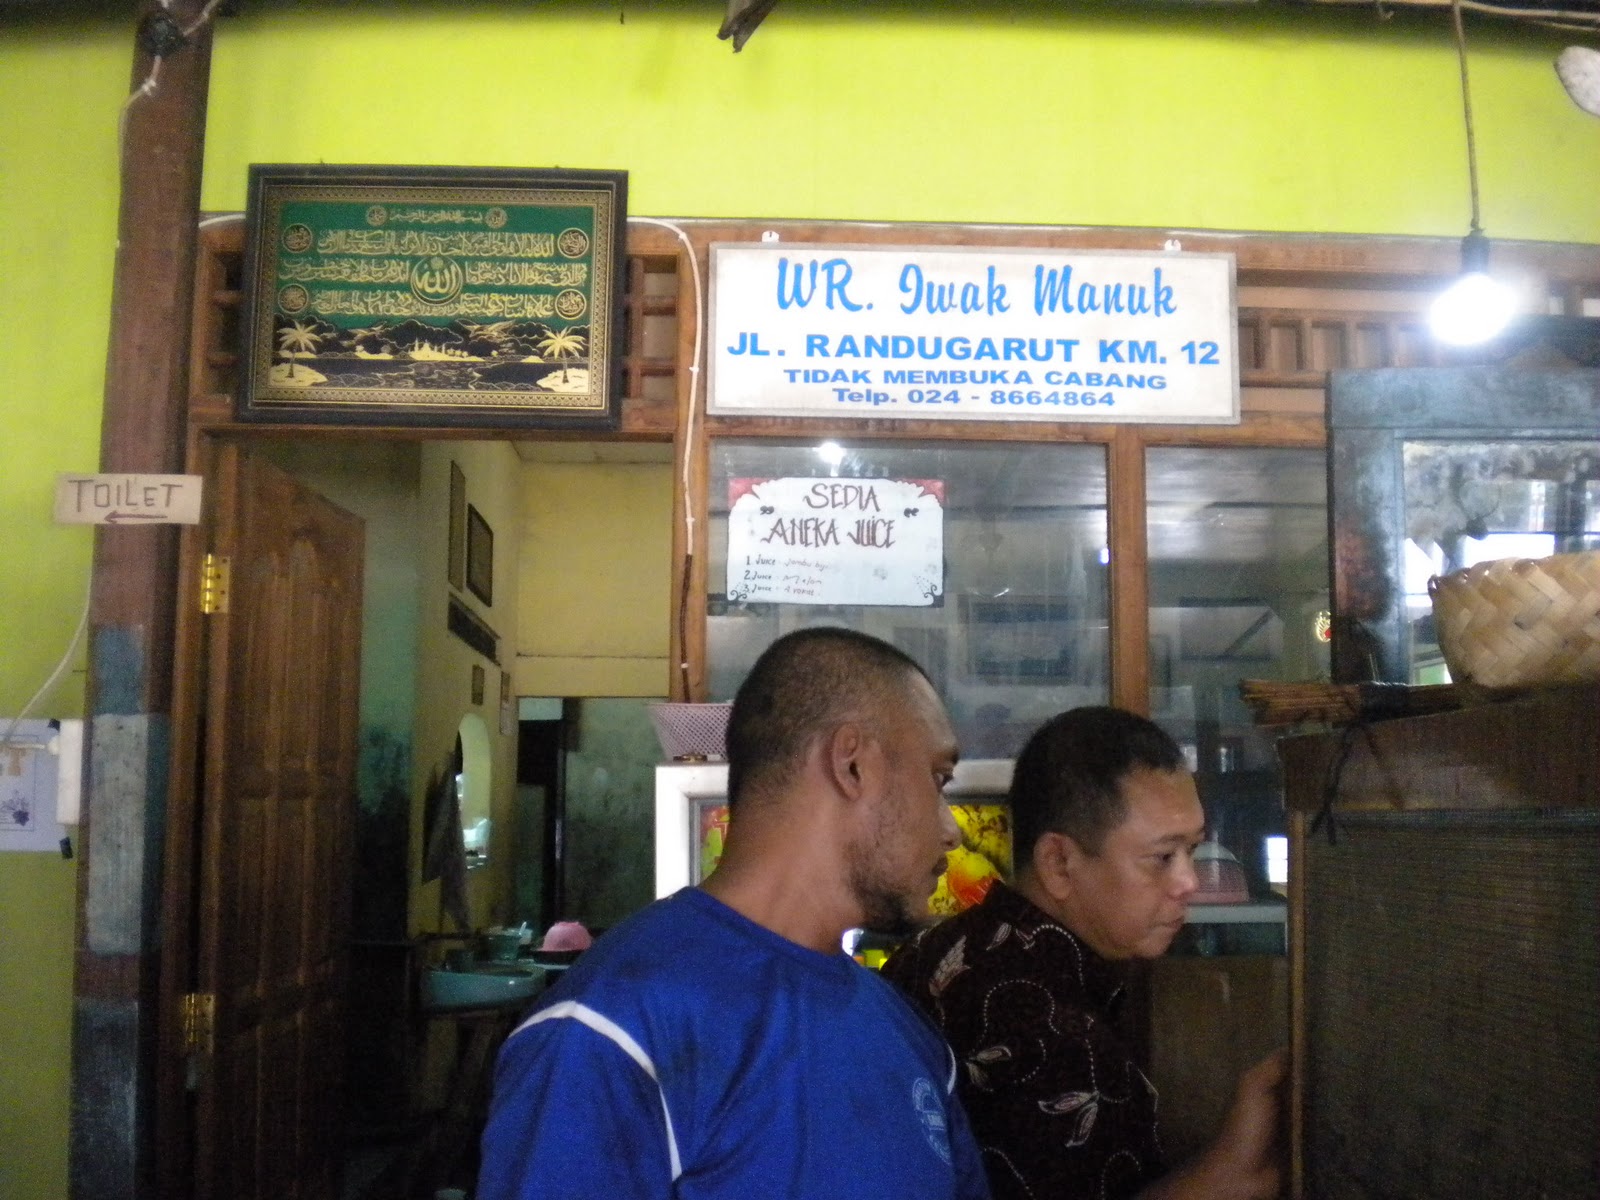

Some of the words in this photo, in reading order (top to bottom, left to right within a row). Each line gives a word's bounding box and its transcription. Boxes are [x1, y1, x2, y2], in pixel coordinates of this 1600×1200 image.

[777, 258, 874, 313] WR.
[899, 264, 1010, 317] Iwak
[1033, 265, 1177, 318] Manuk
[727, 332, 785, 357] JL.
[806, 334, 1081, 363] RANDUGARUT
[1099, 340, 1167, 365] KM.
[1181, 341, 1220, 366] 12
[784, 368, 872, 385] TIDAK
[884, 370, 1033, 386] MEMBUKA
[1045, 371, 1167, 391] CABANG
[832, 388, 897, 405] Telp.
[908, 389, 960, 404] 024
[990, 391, 1116, 407] 8664864
[68, 479, 183, 512] TOILET
[803, 483, 881, 512] SEDIA
[760, 517, 840, 549] ANEKA
